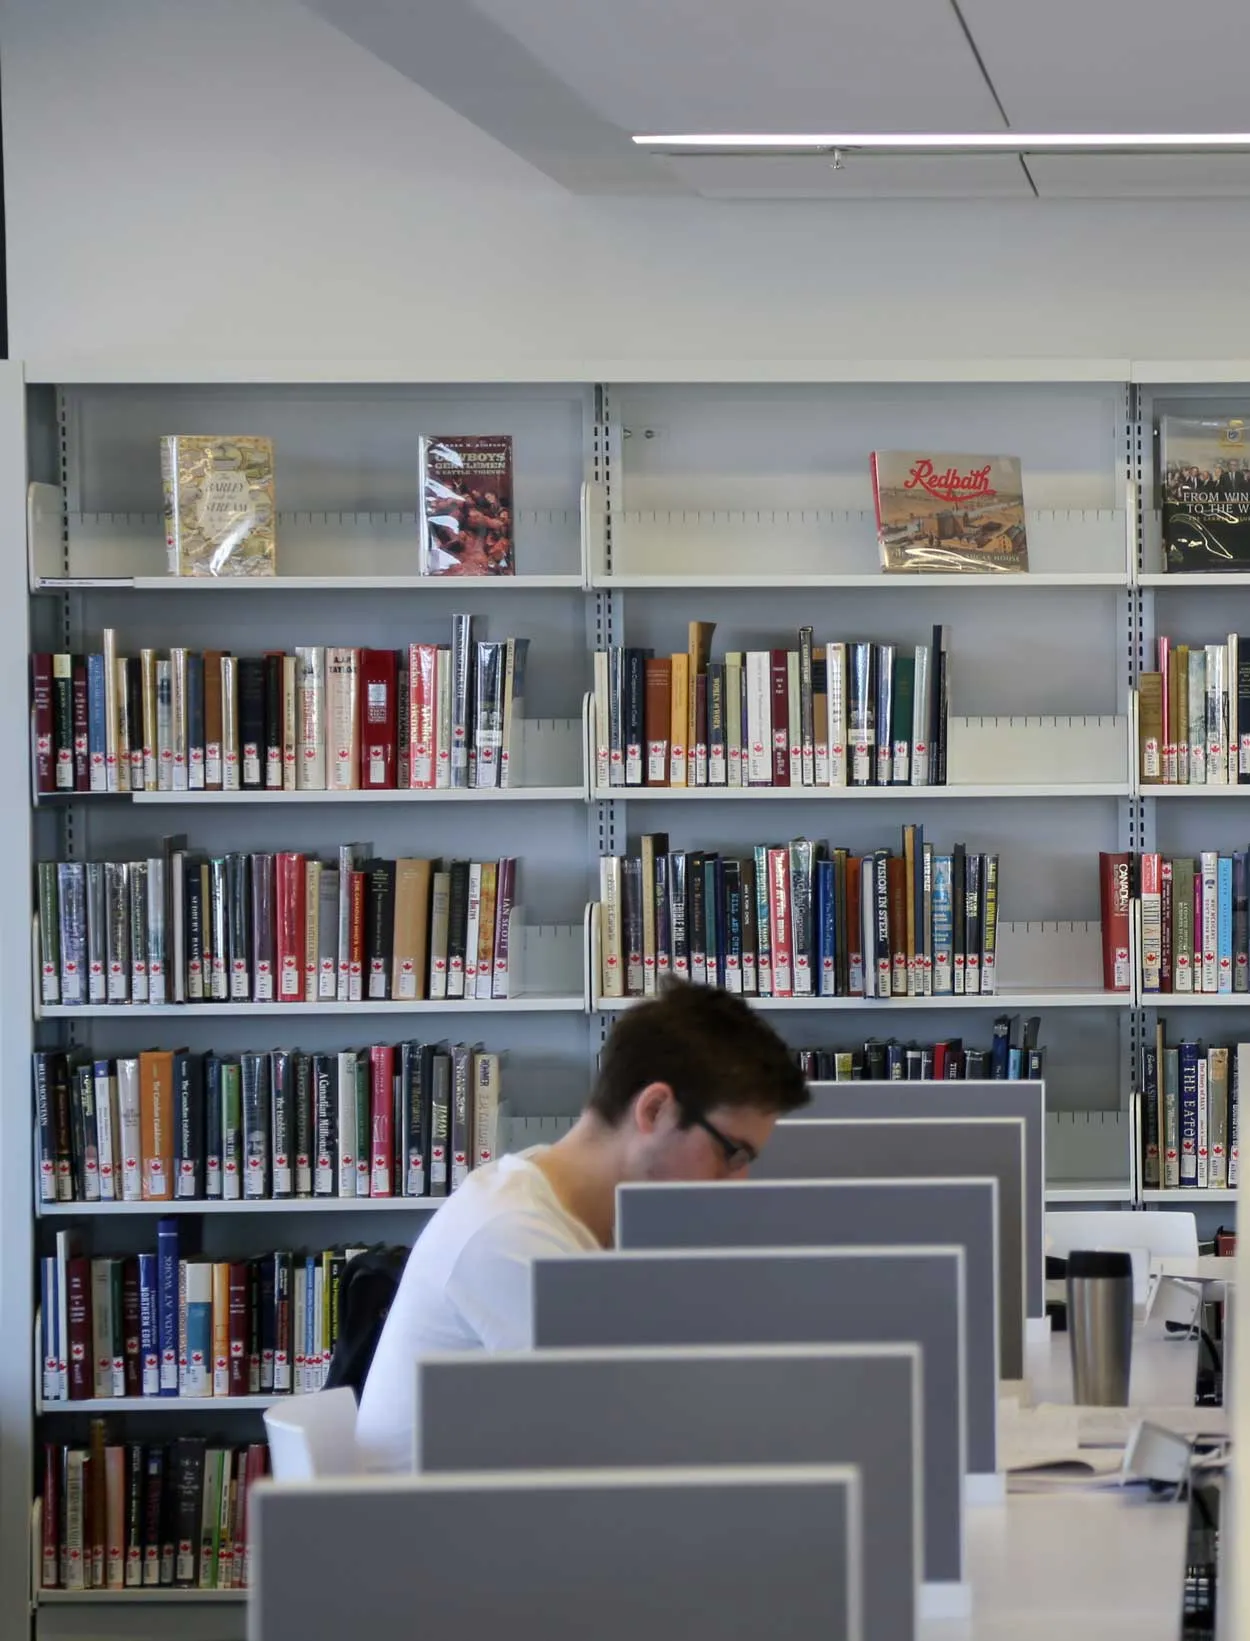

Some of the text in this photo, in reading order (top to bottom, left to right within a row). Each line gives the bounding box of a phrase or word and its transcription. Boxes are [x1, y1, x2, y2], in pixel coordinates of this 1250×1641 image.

[904, 459, 997, 502] Redpath
[1183, 492, 1219, 501] FROM
[1187, 504, 1204, 513] TO
[1210, 504, 1233, 513] THE
[353, 893, 361, 925] CANADIAN
[878, 859, 888, 941] VISION IN STEEL
[1119, 863, 1129, 912] CANADIAN
[190, 896, 199, 933] SUDBURY
[501, 898, 511, 949] IAN SCOTT
[731, 917, 740, 934] AND
[731, 936, 740, 955] CHIL
[318, 1080, 330, 1107] Canadian
[480, 1059, 490, 1087] ROHMER
[39, 1084, 48, 1127] MOUNTAIN
[153, 1092, 161, 1118] Canadian
[181, 1080, 190, 1158] The Canadian Establishment
[432, 1101, 448, 1138] JIMMY
[1183, 1065, 1196, 1137] THE EATO
[275, 1110, 286, 1154] Establishmen
[319, 1109, 329, 1156] Millionai
[141, 1287, 151, 1349] NORTHERN EDGE
[164, 1255, 174, 1351] ANADA AT WORK
